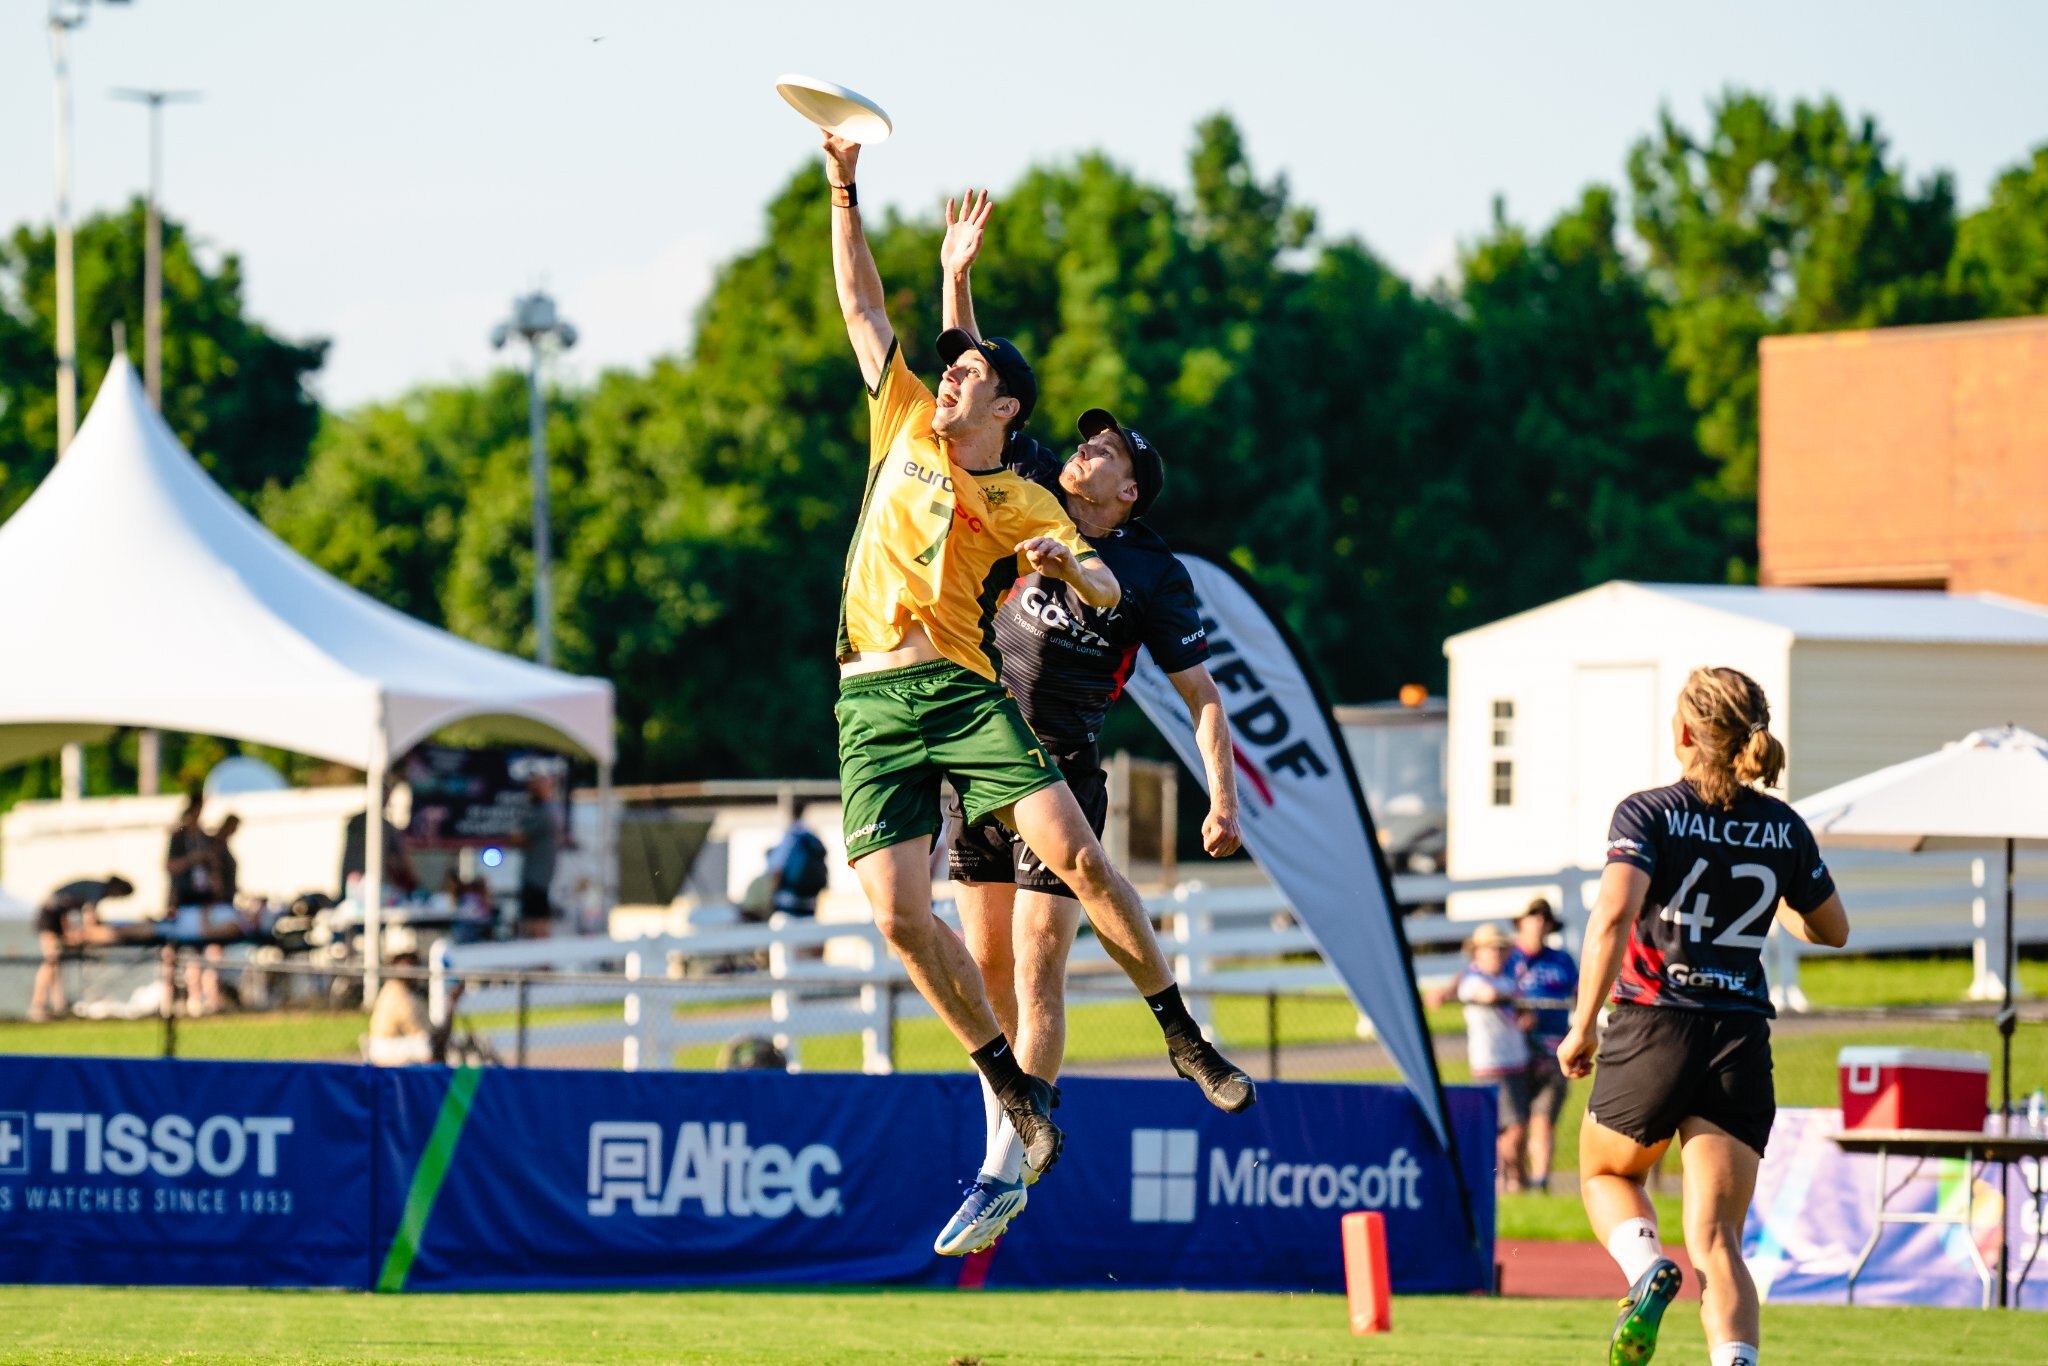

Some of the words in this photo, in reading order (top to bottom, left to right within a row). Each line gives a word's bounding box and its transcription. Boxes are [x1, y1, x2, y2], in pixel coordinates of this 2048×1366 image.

[1131, 431, 1147, 450] GER
[913, 500, 954, 567] 7
[1014, 613, 1048, 639] Pressure
[1049, 635, 1075, 650] under
[1027, 748, 1046, 768] 7
[1664, 808, 1793, 849] WALCZAK
[1659, 857, 1777, 949] 42
[34, 1112, 293, 1177] TISSOT
[658, 1121, 842, 1219] Altec
[25, 1186, 142, 1213] WATCHES
[154, 1187, 226, 1215] SINCE
[240, 1189, 293, 1215] 1853
[1208, 1147, 1423, 1210] Microsoft
